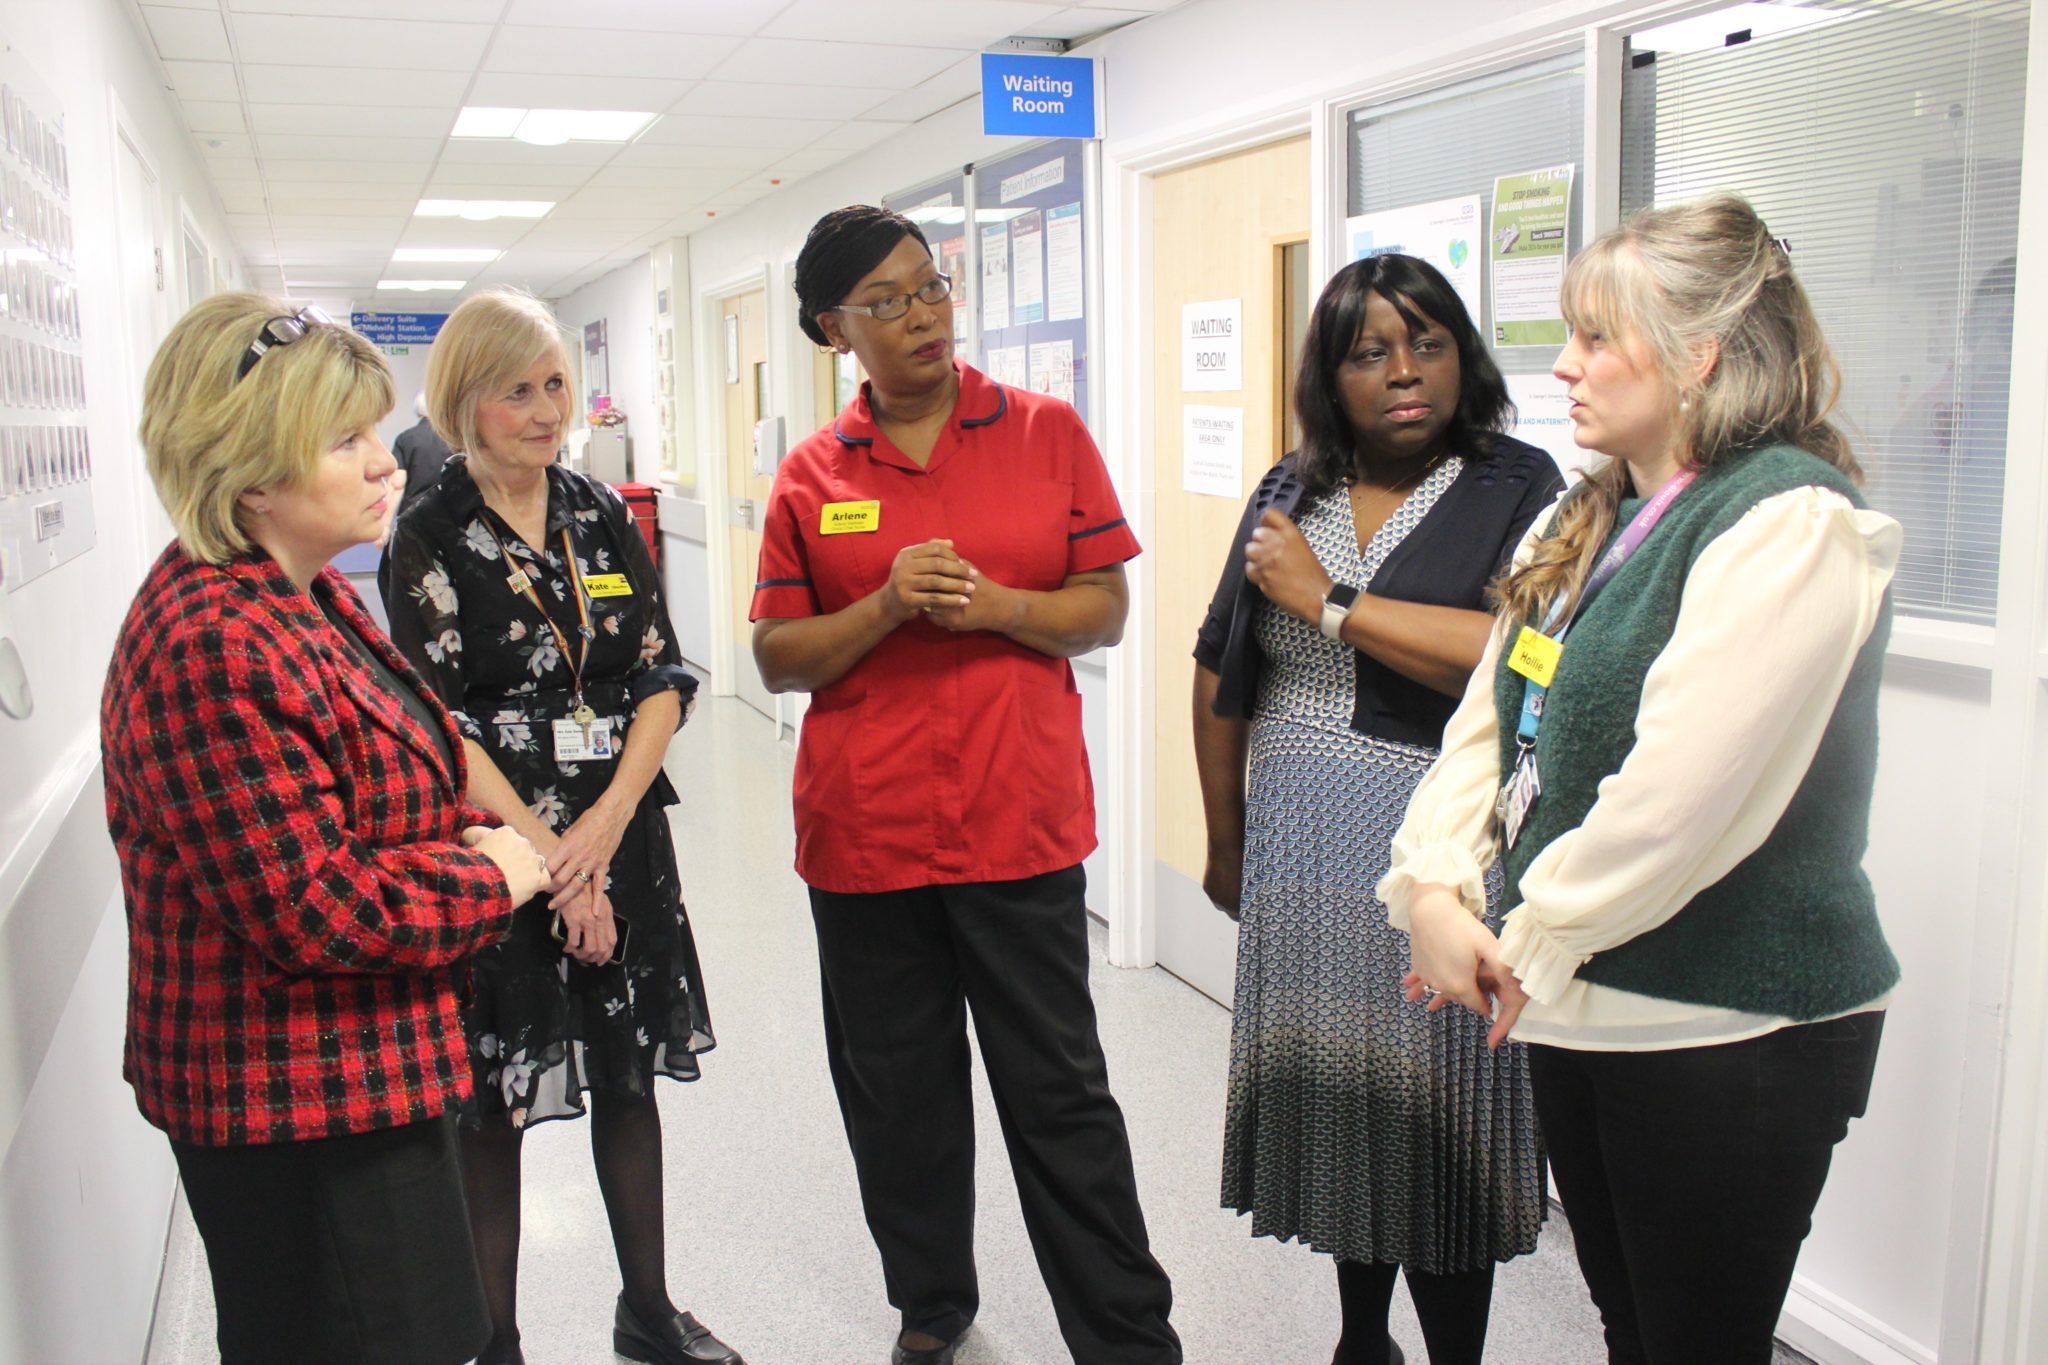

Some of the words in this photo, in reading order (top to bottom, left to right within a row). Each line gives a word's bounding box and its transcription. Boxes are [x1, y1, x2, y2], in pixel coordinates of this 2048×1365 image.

[1002, 74, 1073, 97] Waiting
[1012, 96, 1064, 113] Room
[1002, 176, 1022, 196] Patient
[1025, 166, 1062, 189] Information
[1512, 190, 1526, 200] STOP
[1527, 187, 1551, 198] SMOKING
[362, 315, 395, 323] Delivery
[1191, 318, 1232, 335] WAITING
[376, 334, 395, 342] High
[1197, 352, 1226, 367] ROOM
[1213, 420, 1234, 429] WAITING
[1536, 417, 1571, 425] MATERNITY
[832, 513, 868, 521] Arlene
[587, 583, 609, 591] Kate
[1520, 651, 1544, 672] Hollie
